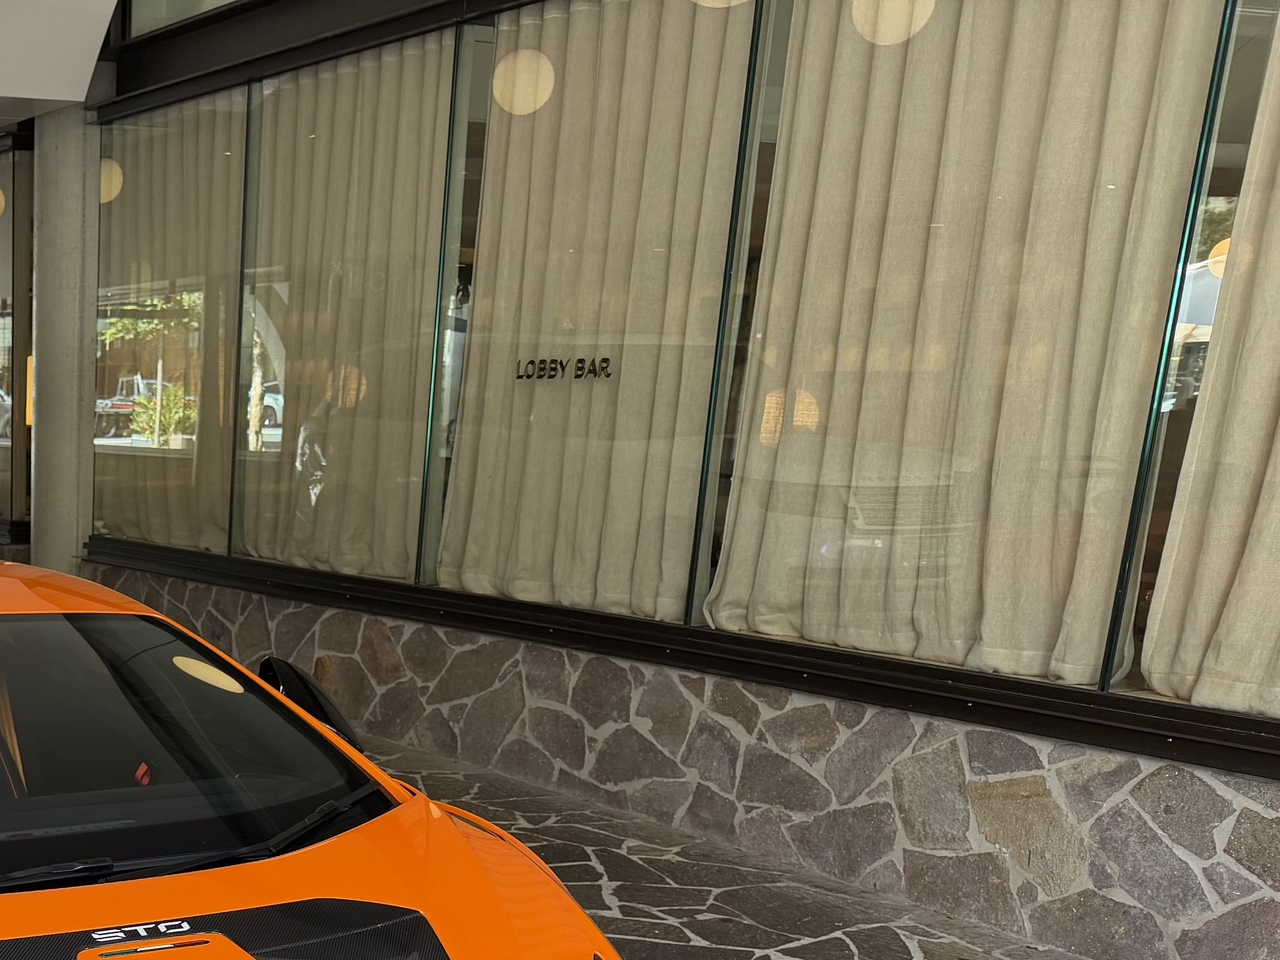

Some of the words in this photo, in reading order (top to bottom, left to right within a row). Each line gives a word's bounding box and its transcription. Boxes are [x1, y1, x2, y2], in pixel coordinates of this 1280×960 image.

[516, 358, 570, 379] LOBBY
[574, 357, 612, 379] BAR
[91, 920, 191, 942] STO
